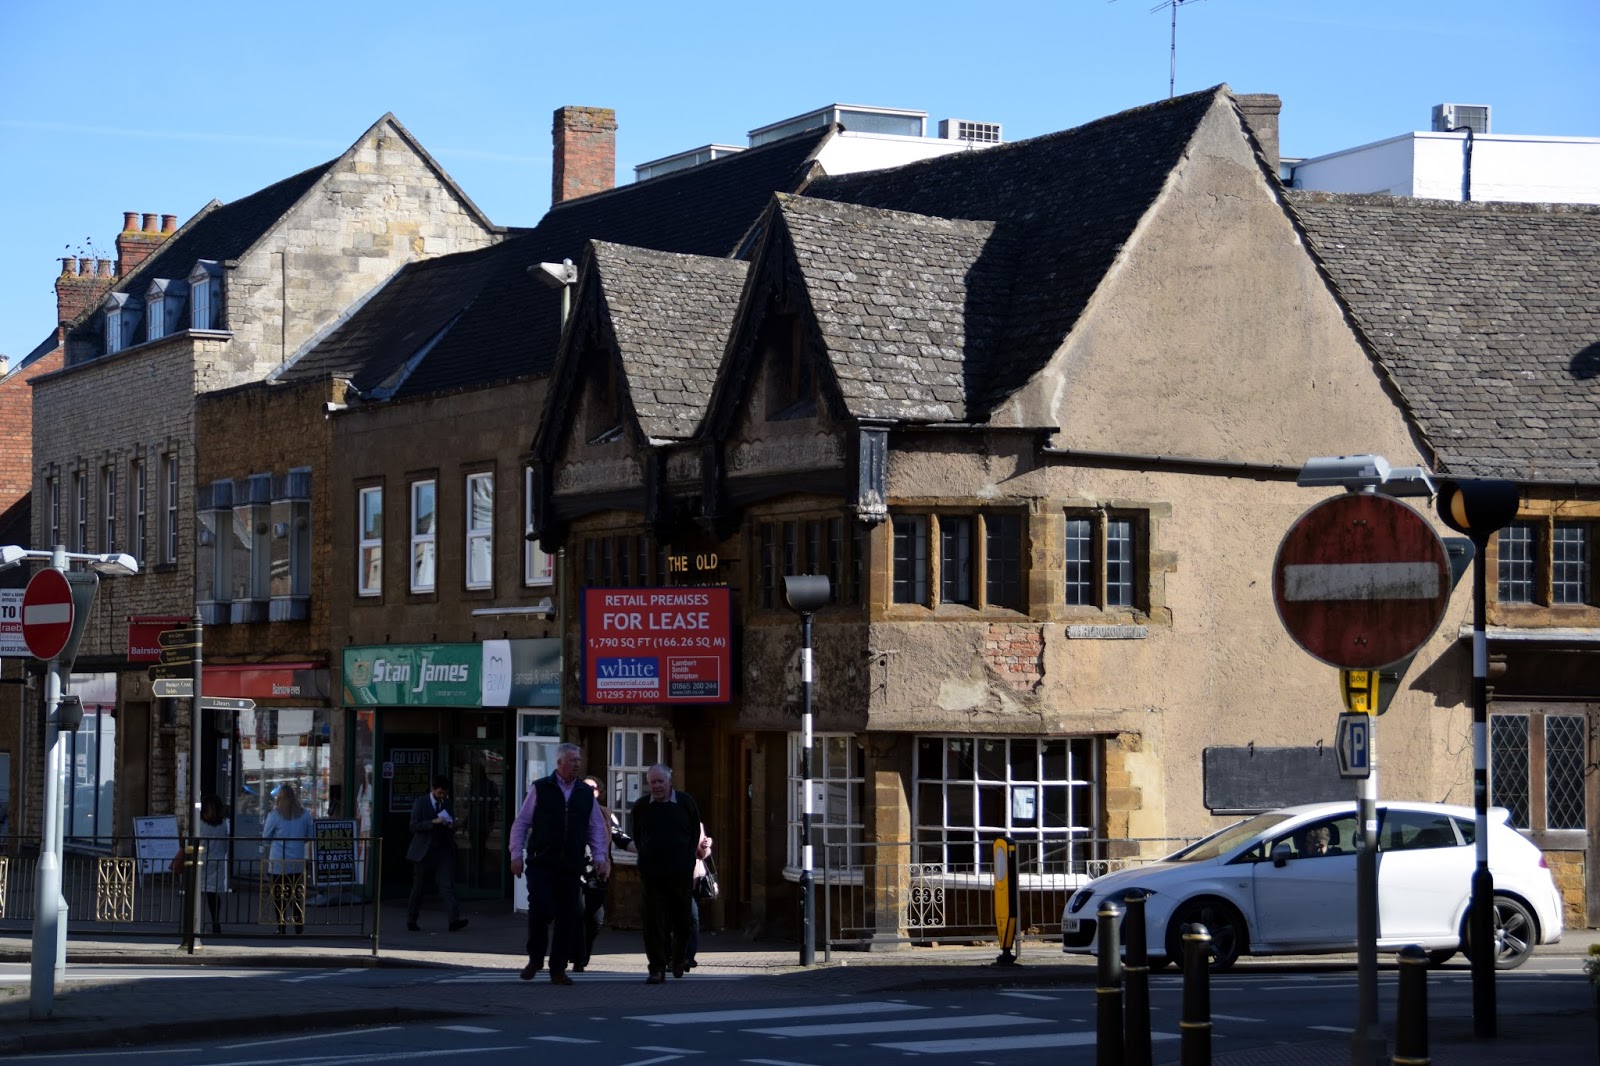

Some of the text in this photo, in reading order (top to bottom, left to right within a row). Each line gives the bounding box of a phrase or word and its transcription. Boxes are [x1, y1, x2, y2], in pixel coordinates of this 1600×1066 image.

[668, 554, 718, 572] THE OLD
[605, 594, 708, 606] RETAIL PREMISES
[2, 606, 16, 618] TO
[603, 612, 709, 630] FOR LEASE
[589, 637, 726, 648] 1,790 SQ FT (166.26 SQ M)
[601, 659, 654, 677] white
[372, 658, 469, 692] Stan James
[272, 684, 300, 694] Bairstow eves
[597, 690, 660, 699] 01295 271000
[1354, 726, 1364, 766] P
[394, 751, 429, 764] GO LIVE!
[318, 829, 352, 838] EARLY
[318, 840, 352, 850] PRICES
[326, 854, 353, 862] RACES
